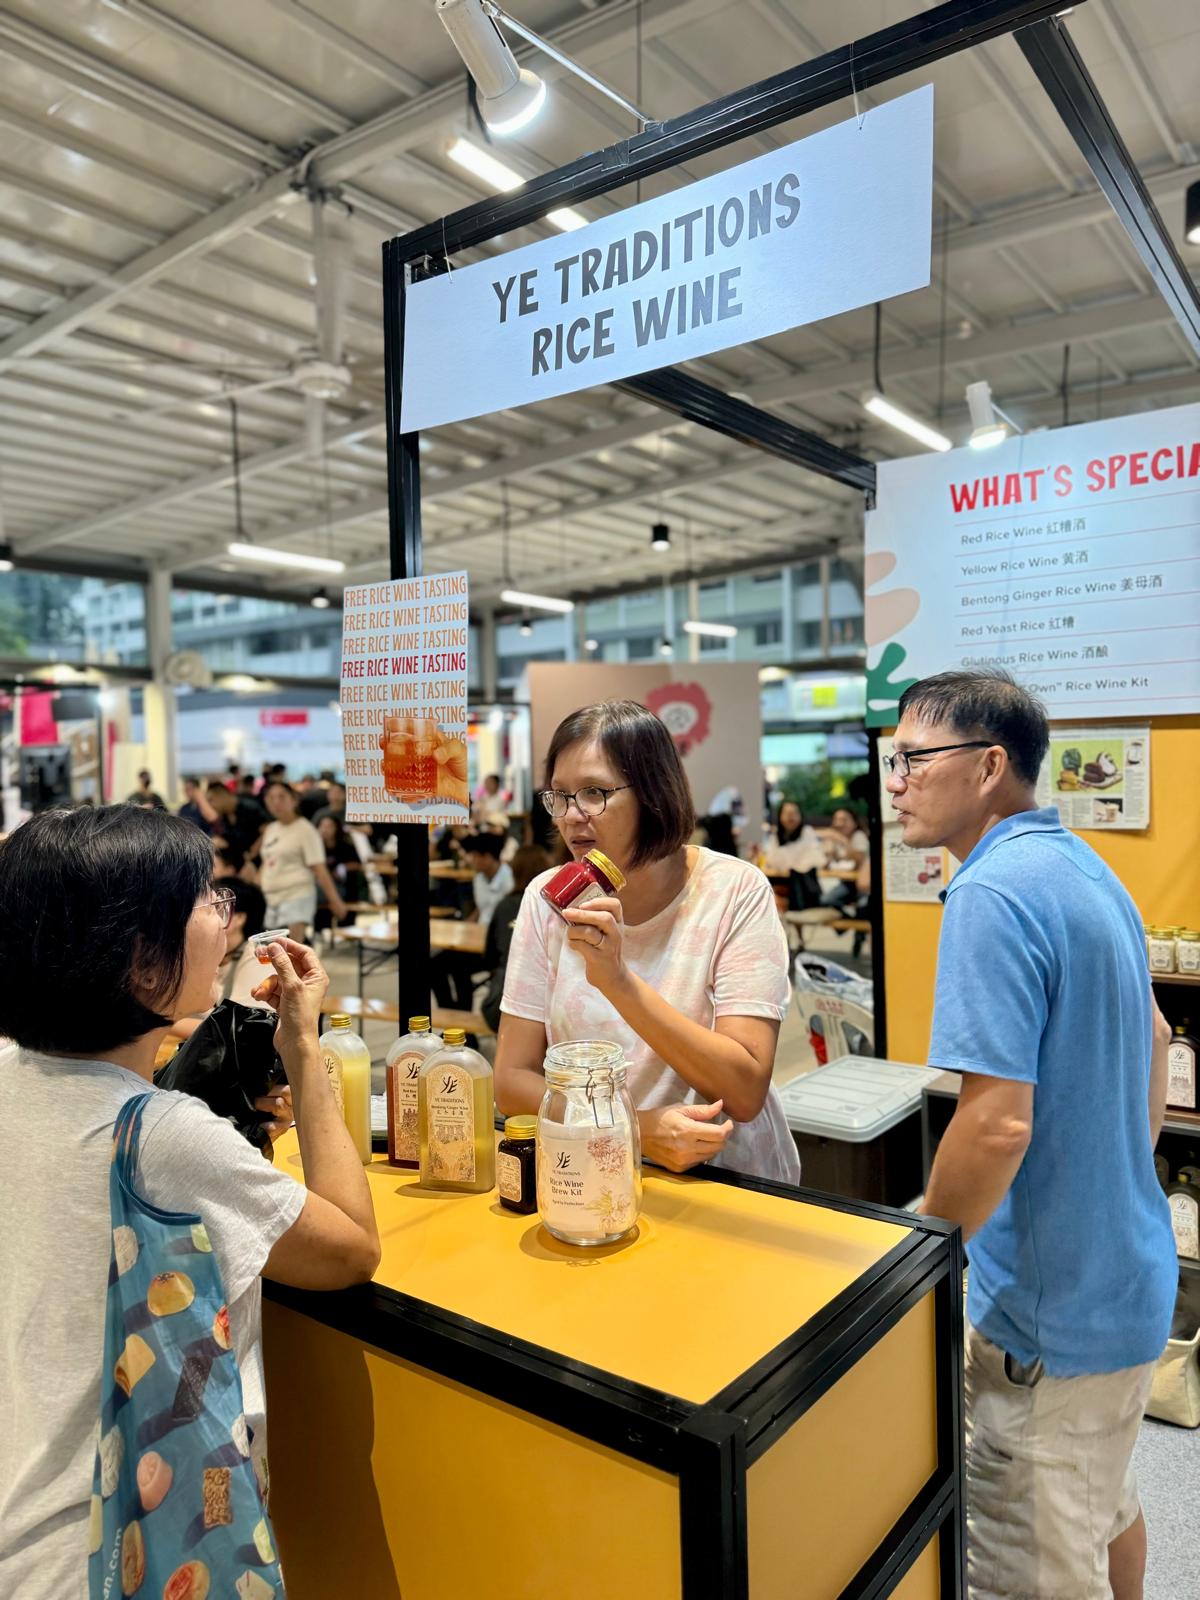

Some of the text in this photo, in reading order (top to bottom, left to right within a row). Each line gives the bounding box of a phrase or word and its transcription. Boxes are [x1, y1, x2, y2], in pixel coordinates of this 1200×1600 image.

[492, 173, 802, 323] YE TRADITIONS
[531, 267, 743, 377] RICE WINE
[950, 464, 1073, 513] WHAT'S
[961, 534, 983, 545] Red
[986, 531, 1010, 541] Rice
[1012, 526, 1043, 538] Wine
[961, 565, 998, 577] Yellow
[1000, 561, 1025, 571] Rice
[1028, 557, 1058, 568] Wine
[345, 576, 466, 608] FREE RICE WINE TASTING
[961, 594, 1009, 607] Bentong
[1012, 589, 1053, 602] Ginger
[1055, 585, 1081, 596] Rice
[1085, 581, 1116, 593] Wine
[344, 602, 467, 631] FREE RICE WINE TASTING
[961, 625, 983, 636] Red
[986, 623, 1017, 634] Yeast
[1020, 620, 1045, 631] Rice
[343, 628, 466, 655] FREE RICE WINE TASTING
[342, 652, 466, 678] FREE RICE WINE TASTING
[961, 654, 1016, 667] Glutinous
[1019, 652, 1044, 663] Rice
[1047, 648, 1078, 660] Wine
[341, 680, 465, 703] FREE RICE WINE TASTING
[1065, 680, 1091, 691] Rice
[1094, 679, 1127, 689] Wine
[1131, 677, 1149, 687] Kit
[342, 709, 365, 727] FREE
[344, 733, 384, 751] FREE RIC
[346, 758, 368, 776] FREE
[347, 786, 369, 803] FREE
[440, 1076, 458, 1093] YE
[555, 1151, 571, 1168] YE
[550, 1177, 584, 1188] Rice Wine
[551, 1185, 582, 1196] Brew Kit
